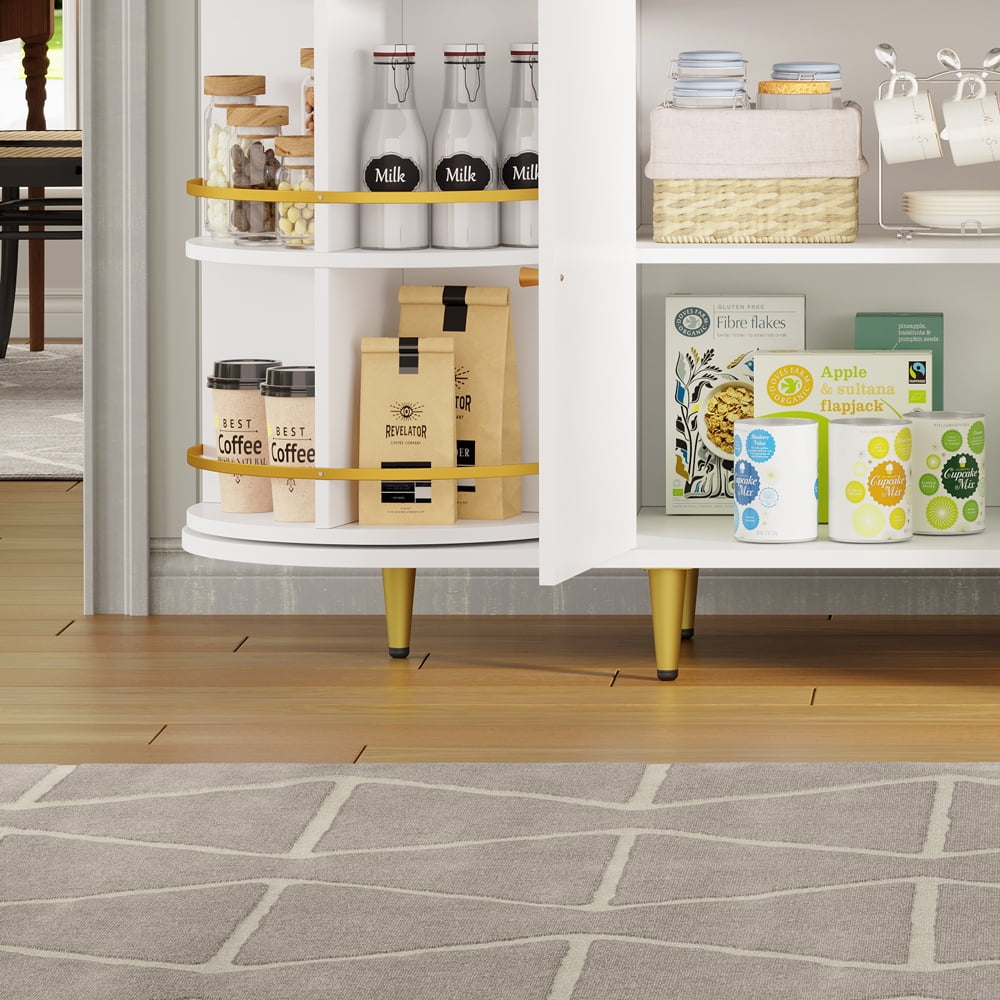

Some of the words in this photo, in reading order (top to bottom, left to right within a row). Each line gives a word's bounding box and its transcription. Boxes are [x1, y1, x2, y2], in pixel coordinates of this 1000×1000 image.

[375, 168, 406, 184] Milk
[446, 168, 477, 183] Milk
[717, 315, 748, 329] Fibre
[751, 315, 786, 329] flakes
[678, 325, 708, 337] ORGANIC
[820, 365, 867, 381] Apple
[774, 386, 811, 404] ORGANIC
[820, 383, 833, 395] &
[837, 382, 895, 395] sultana
[820, 400, 884, 415] flapjack
[222, 418, 252, 429] BEST
[276, 426, 305, 437] BEST
[385, 424, 427, 439] REVELATOR
[218, 434, 262, 455] Coffee
[271, 442, 315, 463] Coffee
[870, 474, 905, 488] Cupcake
[943, 468, 978, 481] Cupcake
[955, 478, 976, 490] Mix
[881, 486, 902, 497] Mix
